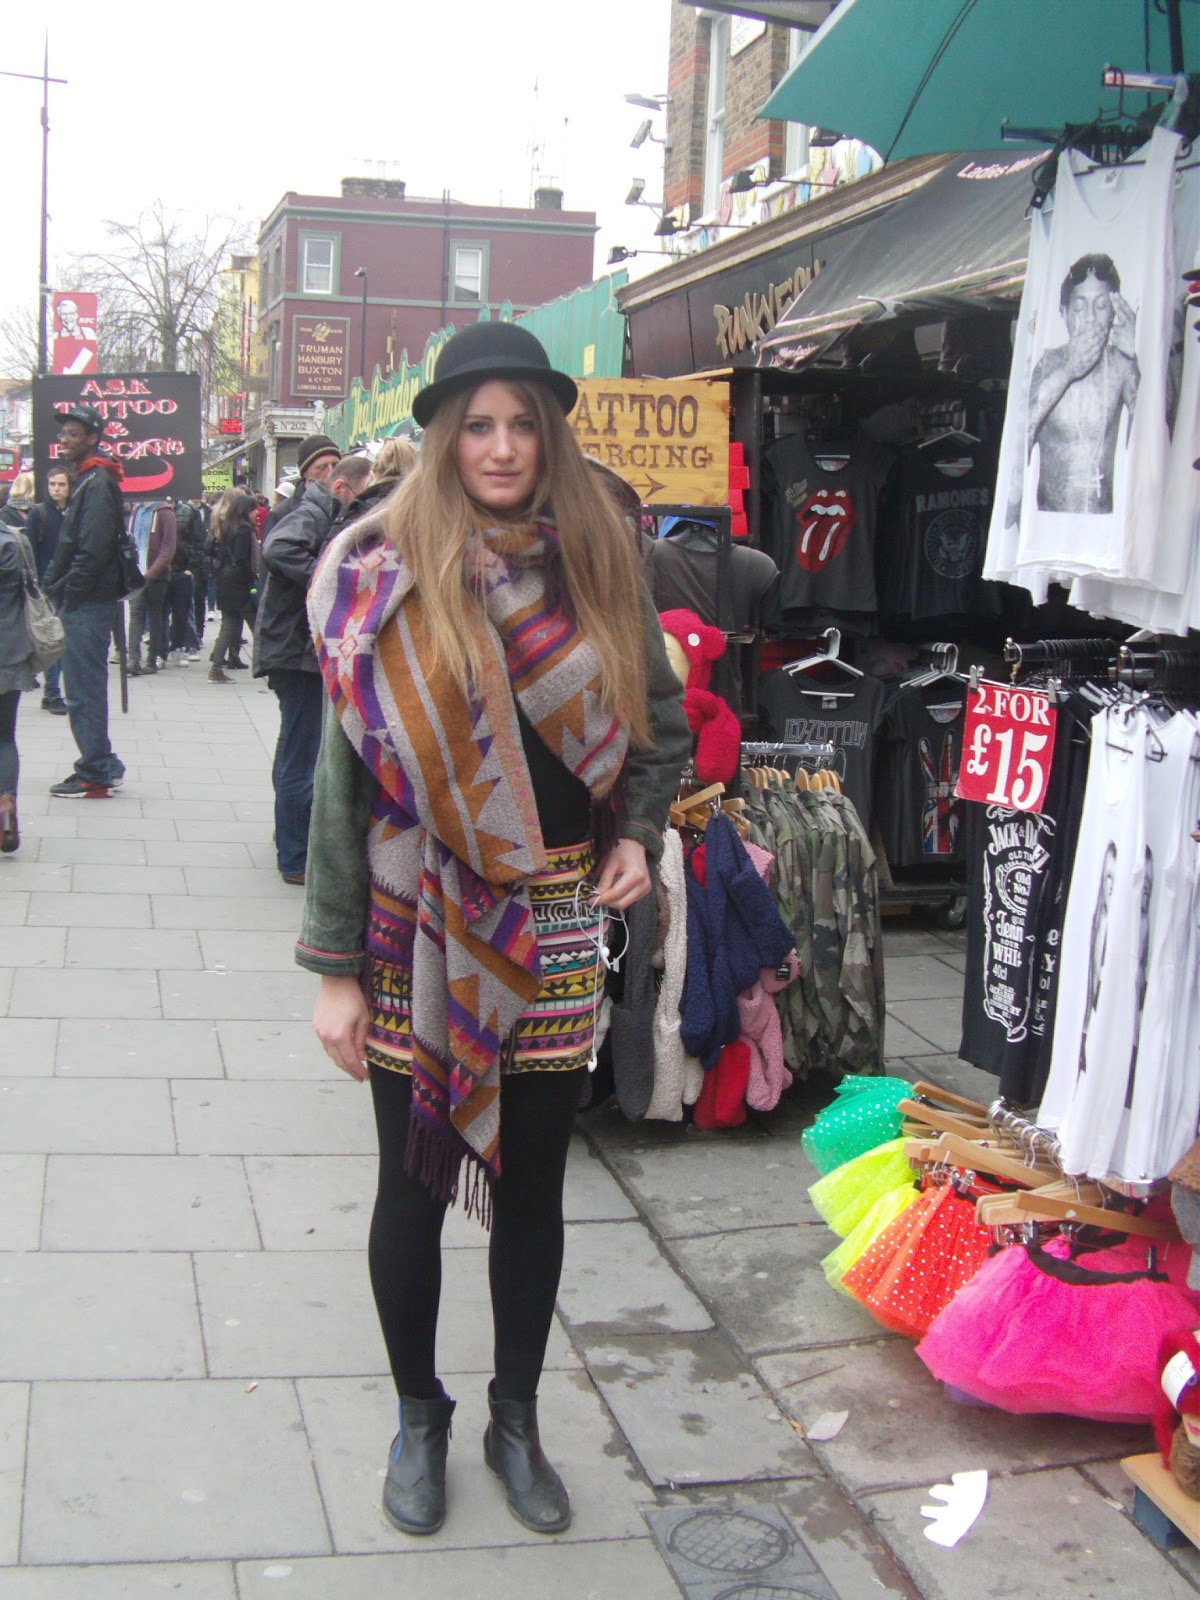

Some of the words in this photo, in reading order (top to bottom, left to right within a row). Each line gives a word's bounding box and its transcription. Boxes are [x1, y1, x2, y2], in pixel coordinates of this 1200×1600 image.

[299, 344, 343, 354] TRUMAN
[298, 355, 342, 365] HANBURY
[298, 366, 342, 375] BUXTON
[53, 399, 178, 420] TTTOO
[103, 421, 129, 439] &
[916, 488, 989, 512] RAMONES
[972, 687, 993, 715] 2
[992, 690, 1051, 726] FOR
[967, 724, 1044, 811] £15
[988, 823, 1021, 856] JACK
